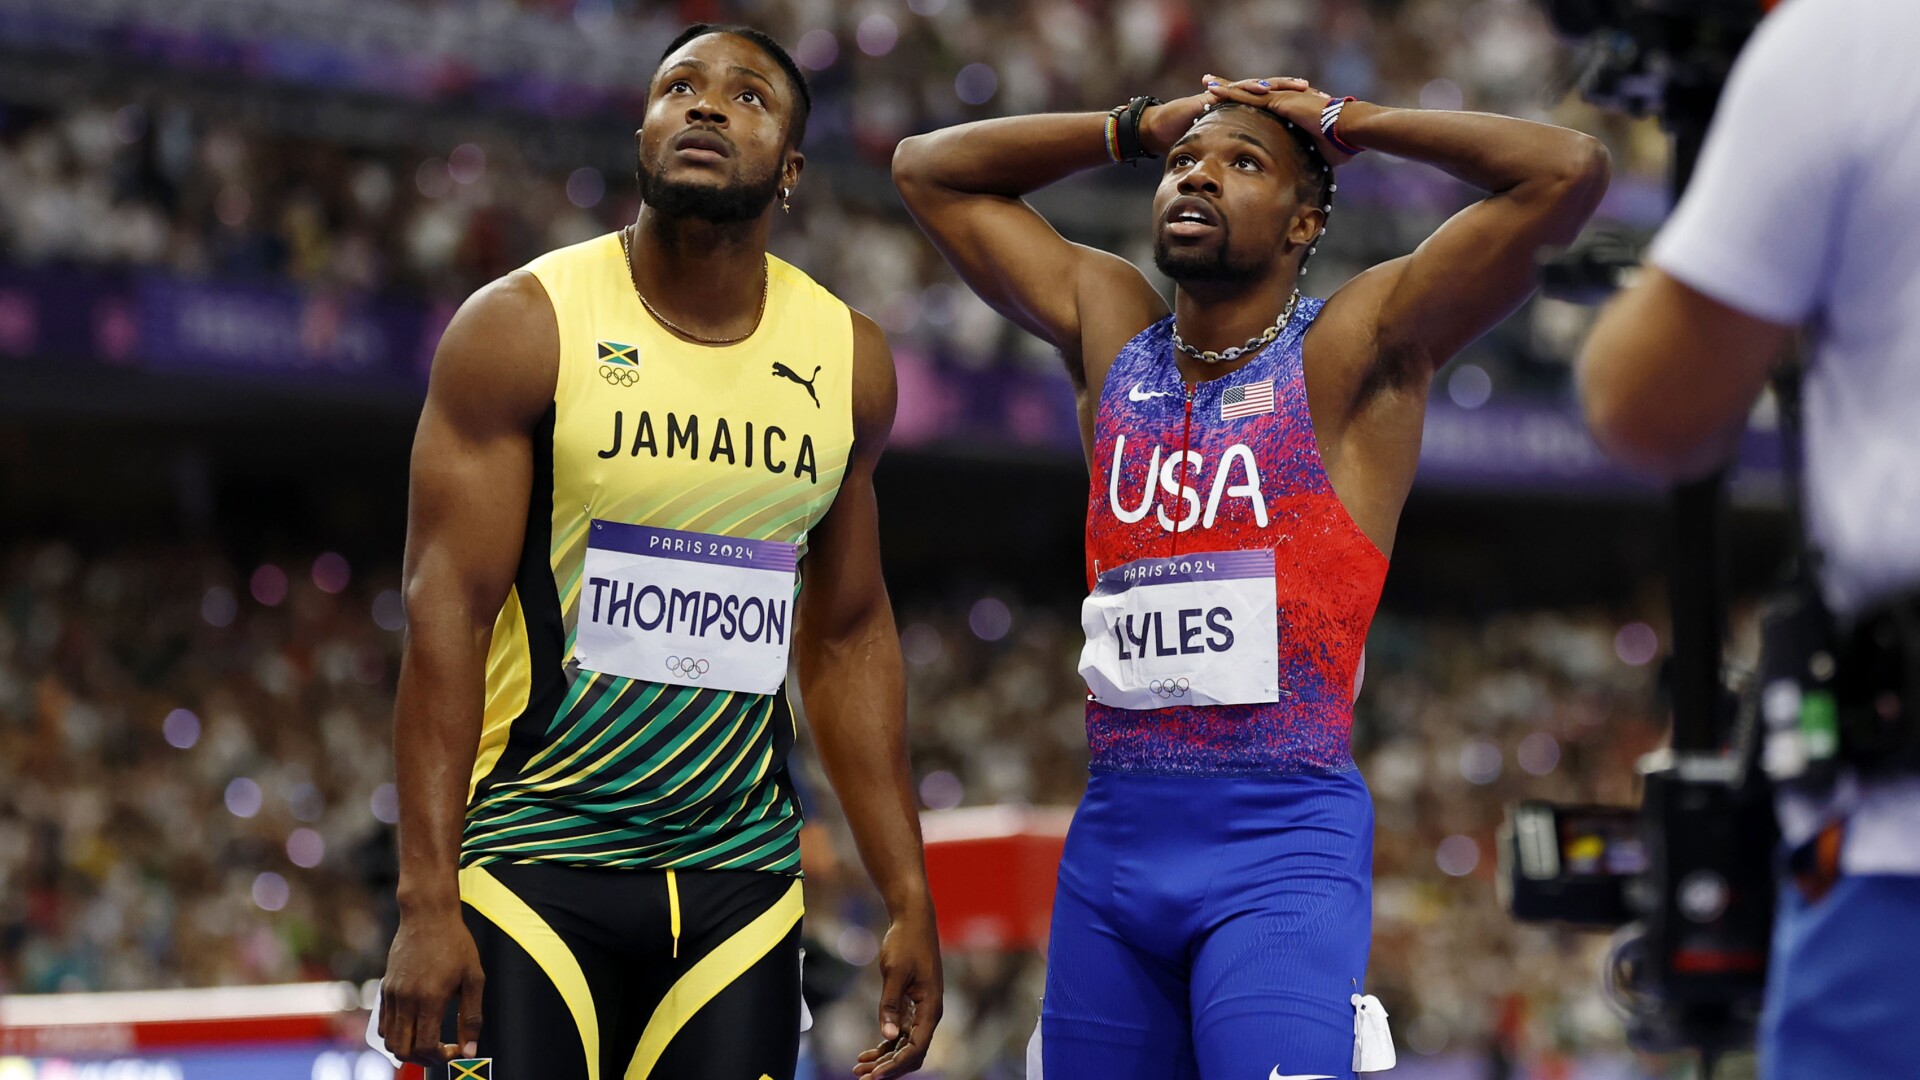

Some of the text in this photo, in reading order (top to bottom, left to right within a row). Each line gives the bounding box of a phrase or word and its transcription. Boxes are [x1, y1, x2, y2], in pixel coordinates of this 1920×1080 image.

[597, 410, 817, 484] JAMAICA
[1109, 434, 1269, 533] USA
[649, 535, 753, 560] PARIS 2024
[1123, 560, 1216, 582] PARIS 2024
[589, 576, 787, 645] THOMPSON
[1114, 606, 1235, 661] LYLES
